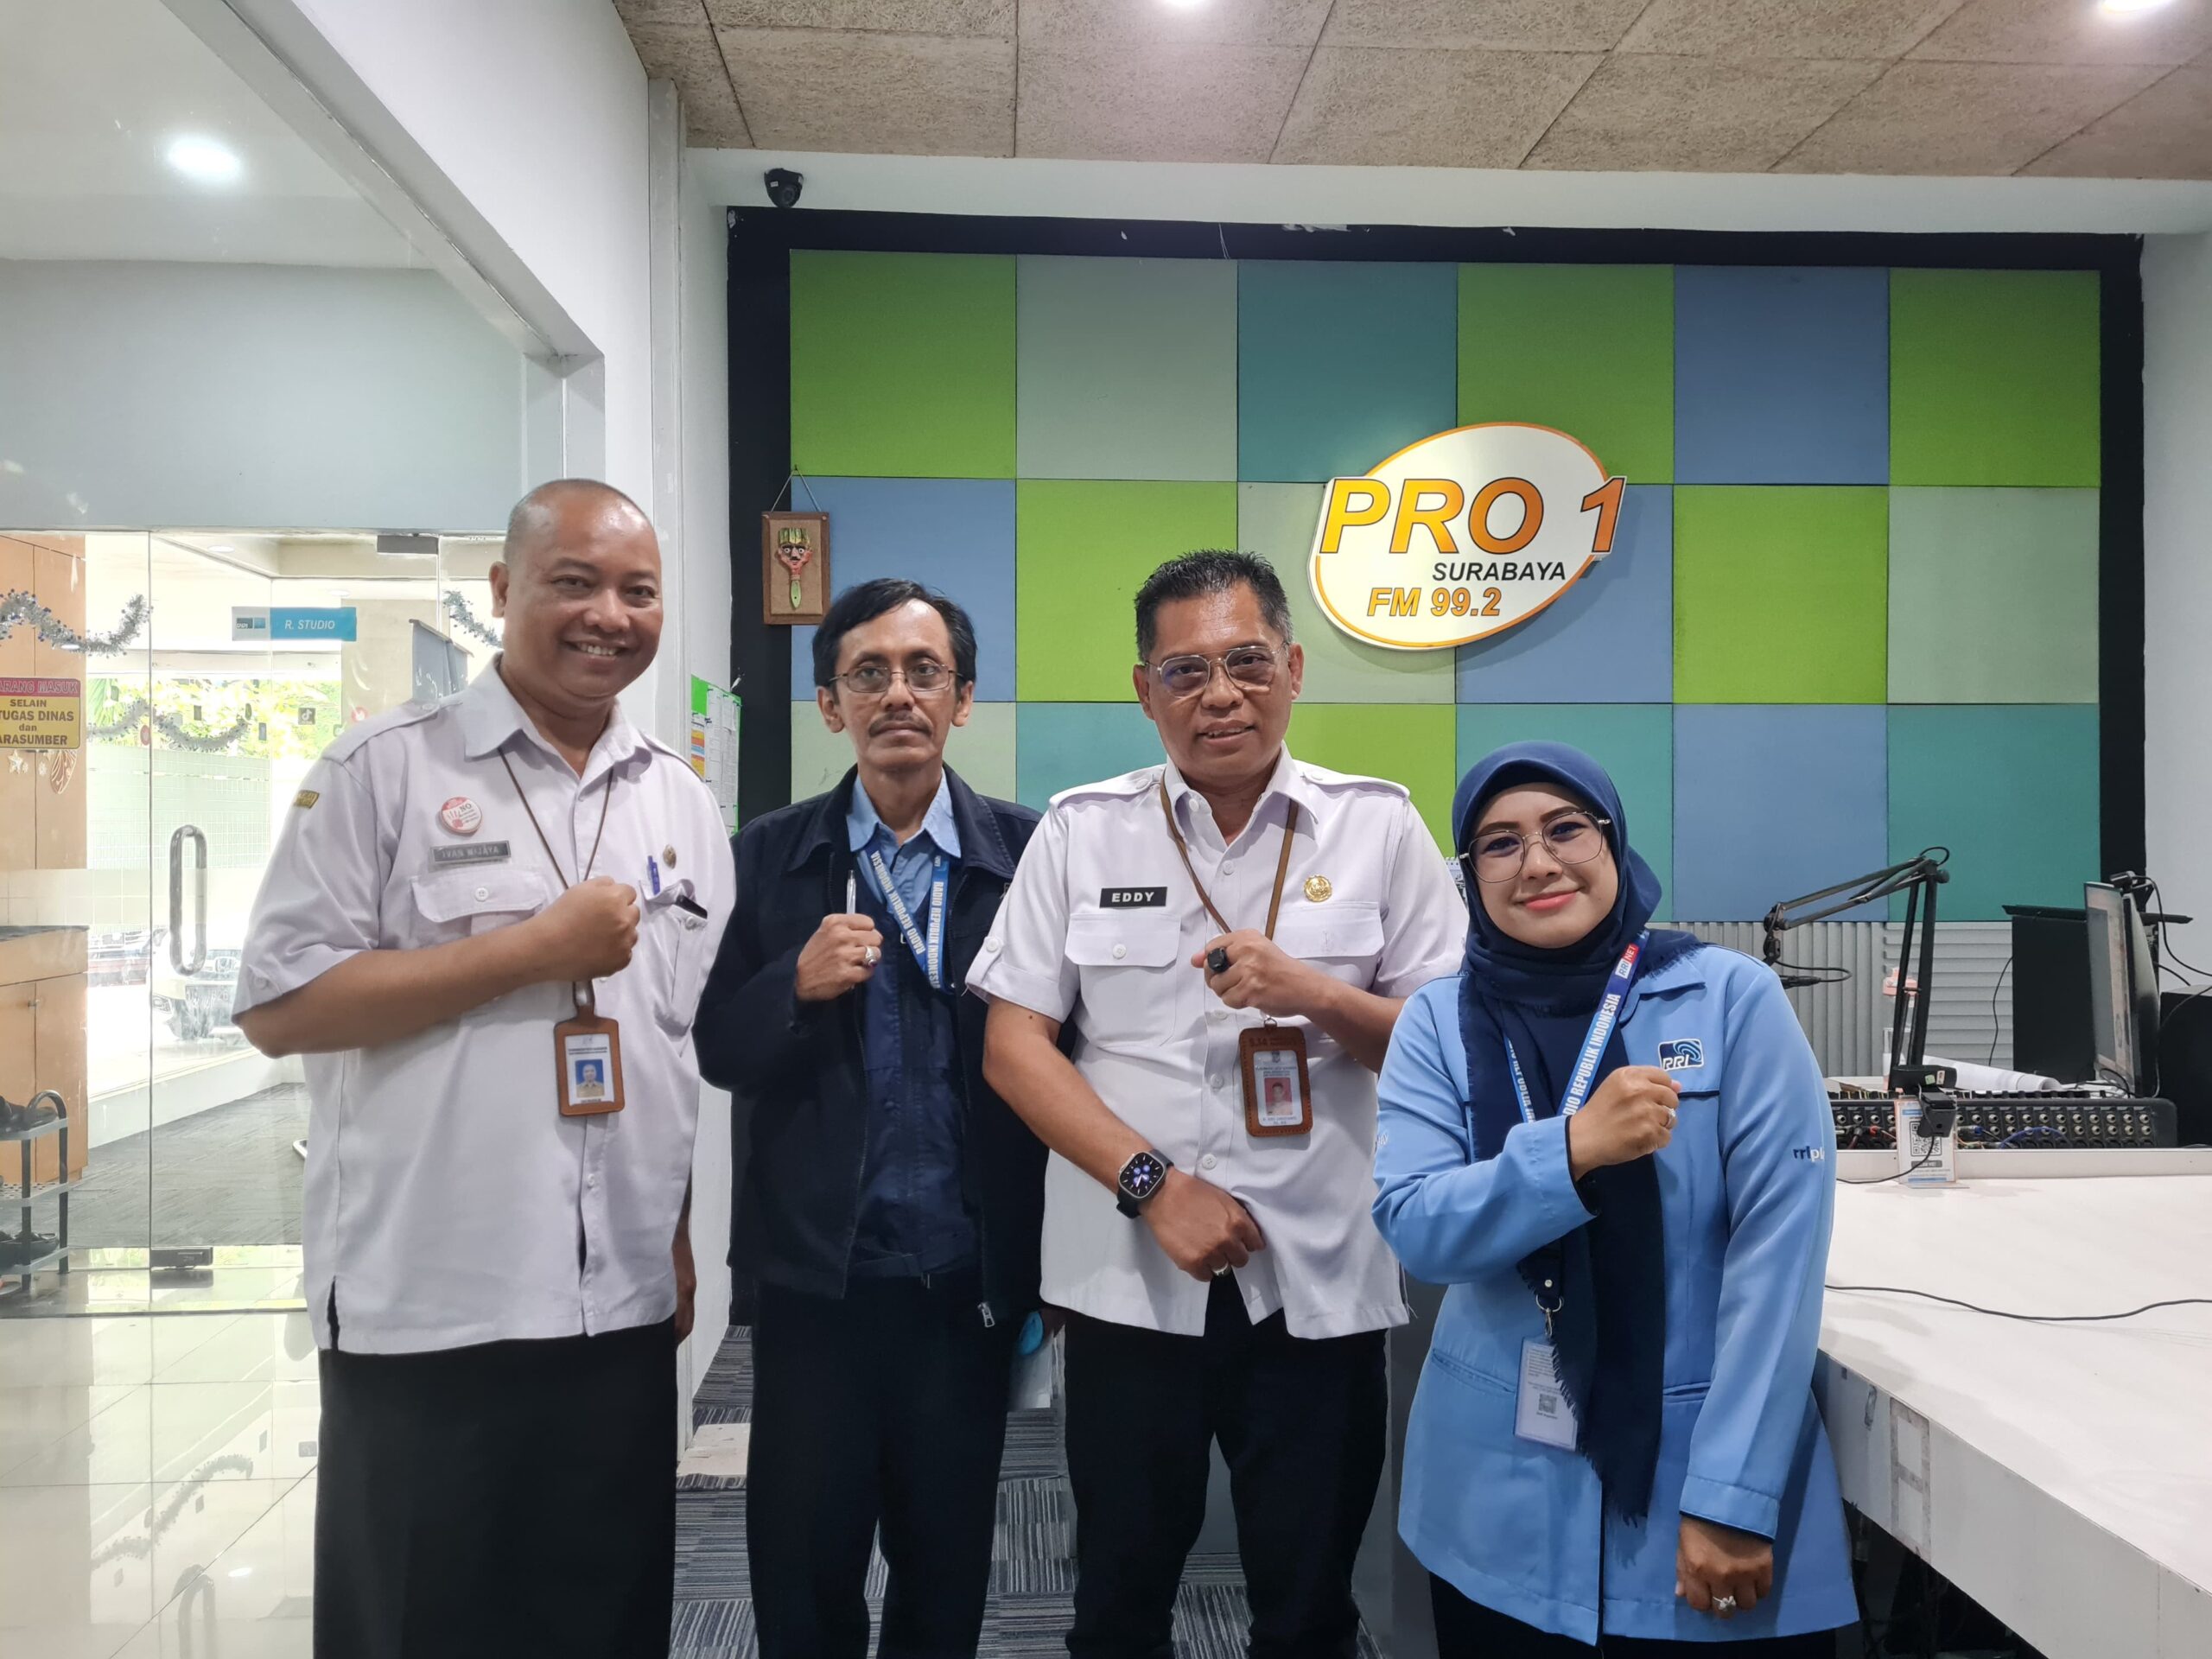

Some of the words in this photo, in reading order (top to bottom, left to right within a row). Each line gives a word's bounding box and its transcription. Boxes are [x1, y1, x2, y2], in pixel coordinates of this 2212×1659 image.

[1319, 476, 1545, 555] PRO
[1580, 476, 1626, 554] 1
[1432, 562, 1567, 582] SURABAYA
[1366, 587, 1422, 617] FM
[1429, 586, 1503, 617] 99.2
[284, 620, 295, 630] R.
[297, 620, 335, 630] STUDIO
[37, 680, 78, 694] MASUK
[10, 698, 47, 708] SELAIN
[38, 710, 74, 721] DINAS
[18, 723, 37, 732] dan
[459, 803, 473, 812] NO
[870, 849, 894, 893] INDONESIA
[932, 881, 944, 906] RADIO
[1111, 891, 1155, 903] EDDY
[888, 889, 913, 931] REPUBLIK
[928, 907, 942, 945] REPUBLIK
[907, 928, 926, 955] RADIO
[1618, 960, 1630, 976] RRI
[1624, 944, 1637, 962] NET
[1591, 993, 1621, 1047] INDONESIA
[1570, 1046, 1599, 1097] REPUBLIK
[1662, 1053, 1690, 1071] RRI
[1562, 1096, 1580, 1116] DIO
